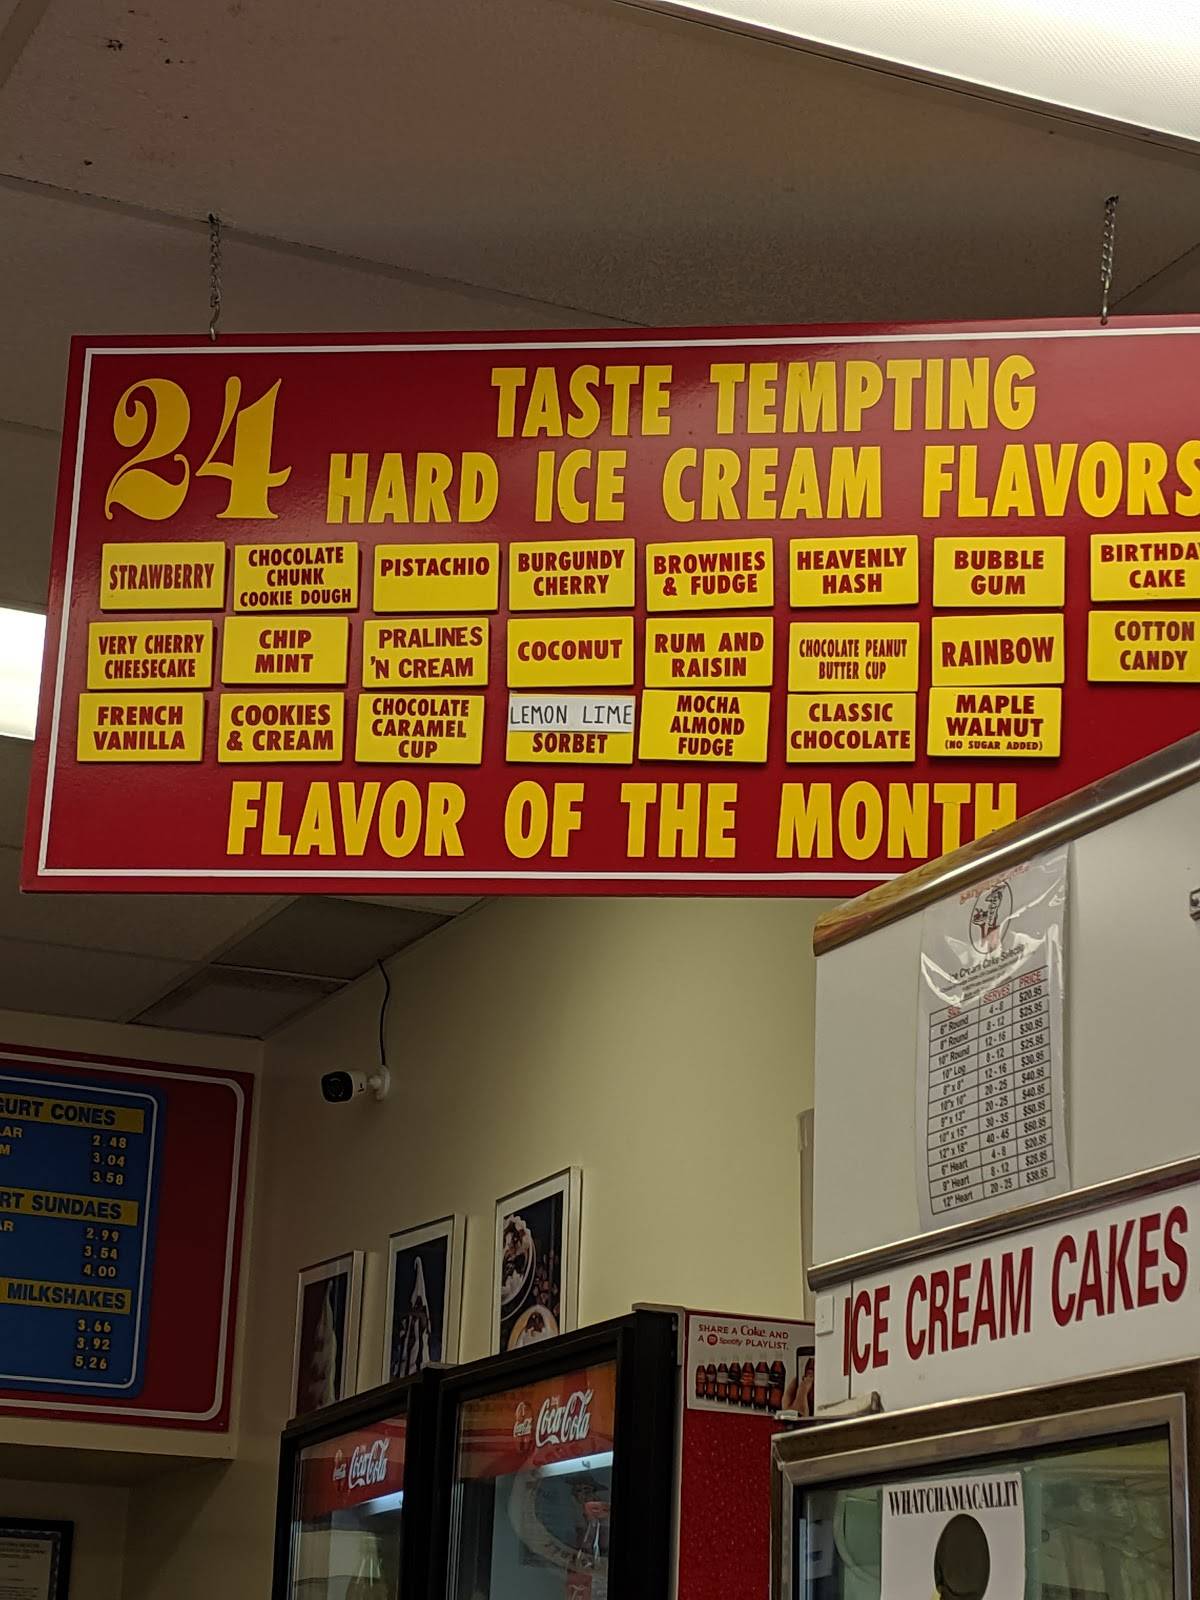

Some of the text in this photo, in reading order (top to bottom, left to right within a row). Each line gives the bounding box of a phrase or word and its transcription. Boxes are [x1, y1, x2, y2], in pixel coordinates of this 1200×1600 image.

[492, 355, 1036, 438] TASTE TEMPTING
[105, 377, 290, 520] 24
[327, 440, 1200, 523] HARD ICE CREAM FLAVORS
[249, 547, 343, 566] CHOCOLATE
[519, 550, 624, 572] BURGUNDY
[798, 548, 906, 570] HEAVENLY
[955, 551, 1043, 570] BUBBLE
[1102, 543, 1200, 562] BIRTHDA
[381, 557, 489, 576] PISTACHIO
[654, 551, 765, 574] BROWNIES
[110, 564, 214, 590] STRAWBERRY
[267, 568, 324, 586] CHUNK
[534, 575, 609, 596] CHERRY
[663, 574, 757, 596] & FUDGE
[823, 574, 881, 594] HASH
[971, 575, 1025, 595] GUM
[1130, 570, 1185, 588] CAKE
[240, 589, 351, 607] COOKIE DOUGH
[259, 630, 311, 649] CHIP
[379, 627, 482, 648] PRALINES
[1115, 621, 1194, 641] COTTON
[99, 635, 204, 655] VERY CHERRY
[518, 640, 622, 661] COCONUT
[655, 632, 763, 653] RUM AND
[800, 639, 907, 657] CHOCOLATE PEANUT
[942, 637, 1054, 667] RAINBOW
[105, 659, 195, 679] CHEESECAKE
[255, 654, 313, 673] MINT
[371, 656, 473, 679] 'N CREAM
[672, 657, 746, 677] RAISIN
[1120, 650, 1187, 670] CANDY
[819, 662, 886, 679] BUTTER CUP
[373, 698, 469, 716] CHOCOLATE
[677, 695, 739, 714] MOCHA
[809, 703, 892, 722] CLASSIC
[956, 695, 1034, 714] MAPLE
[98, 706, 182, 725] FRENCH
[231, 704, 330, 726] COOKIES
[510, 705, 632, 725] LEMON LIME
[372, 719, 466, 737] CARAMEL
[670, 716, 744, 735] ALMOND
[947, 717, 1043, 737] WALNUT
[94, 731, 184, 750] VANILLA
[227, 730, 333, 751] & CREAM
[399, 740, 437, 758] CUP
[533, 733, 608, 753] SORBET
[679, 737, 733, 756] FUDGE
[791, 731, 910, 749] CHOCOLATE
[227, 780, 1017, 858] FLAVOR OF THE MONTH
[51, 1103, 117, 1126] CONES
[92, 1135, 127, 1148] 2.48
[92, 1152, 125, 1167] 3.04
[32, 1195, 122, 1219] SUNDAES
[86, 1228, 119, 1242] 2.99
[84, 1246, 118, 1260] 3.54
[83, 1264, 117, 1278] 4.00
[7, 1282, 126, 1309] MILKSHAKES
[843, 1205, 1189, 1376] ICE CREAM CAKES
[77, 1319, 112, 1333] 3.66
[698, 1324, 788, 1339] SHARE A Coke AND
[76, 1337, 110, 1350] 3.92
[697, 1335, 704, 1343] A
[74, 1355, 108, 1369] 5.26
[888, 1480, 1020, 1516] WHATCHAMACALLIT
